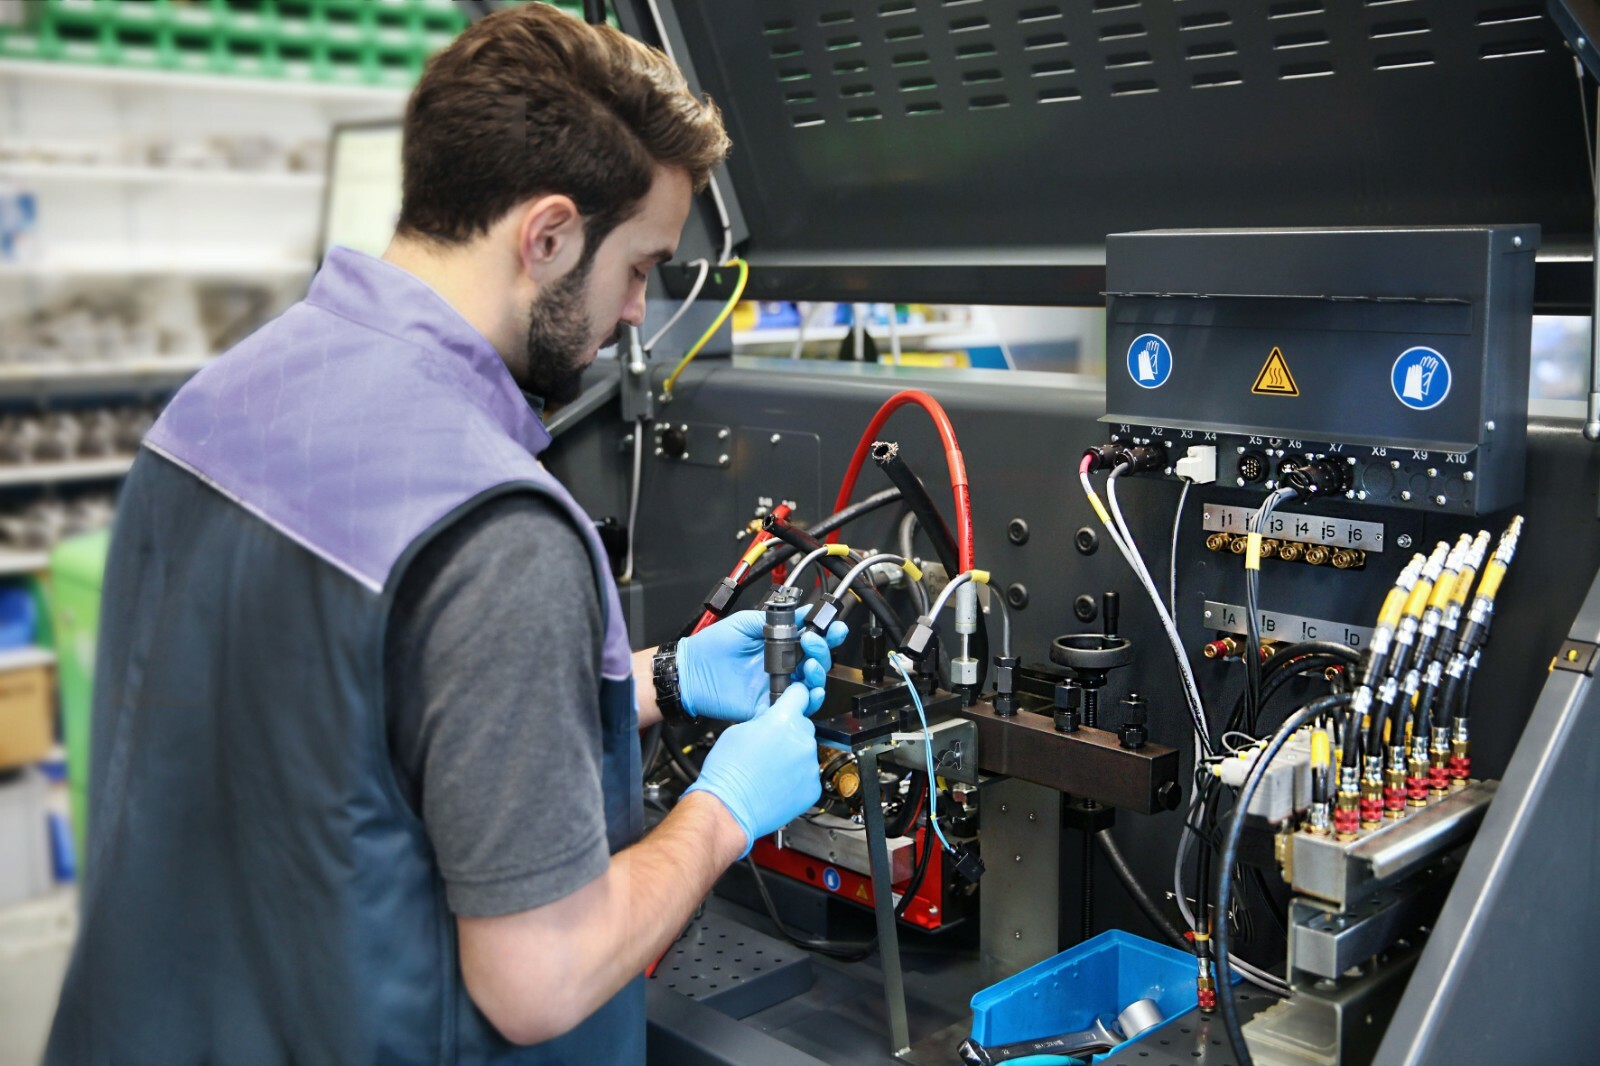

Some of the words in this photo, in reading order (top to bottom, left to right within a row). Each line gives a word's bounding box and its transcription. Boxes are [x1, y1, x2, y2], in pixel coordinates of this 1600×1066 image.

[1120, 424, 1131, 434] X1
[1151, 426, 1163, 436] X2
[1181, 430, 1194, 439] X3
[1204, 432, 1217, 441] X4
[1249, 435, 1262, 445] X5
[1288, 439, 1302, 449] X6
[1329, 443, 1343, 452] X7
[1371, 447, 1386, 457] X8
[1412, 450, 1428, 460] X9
[1446, 453, 1467, 464] X10
